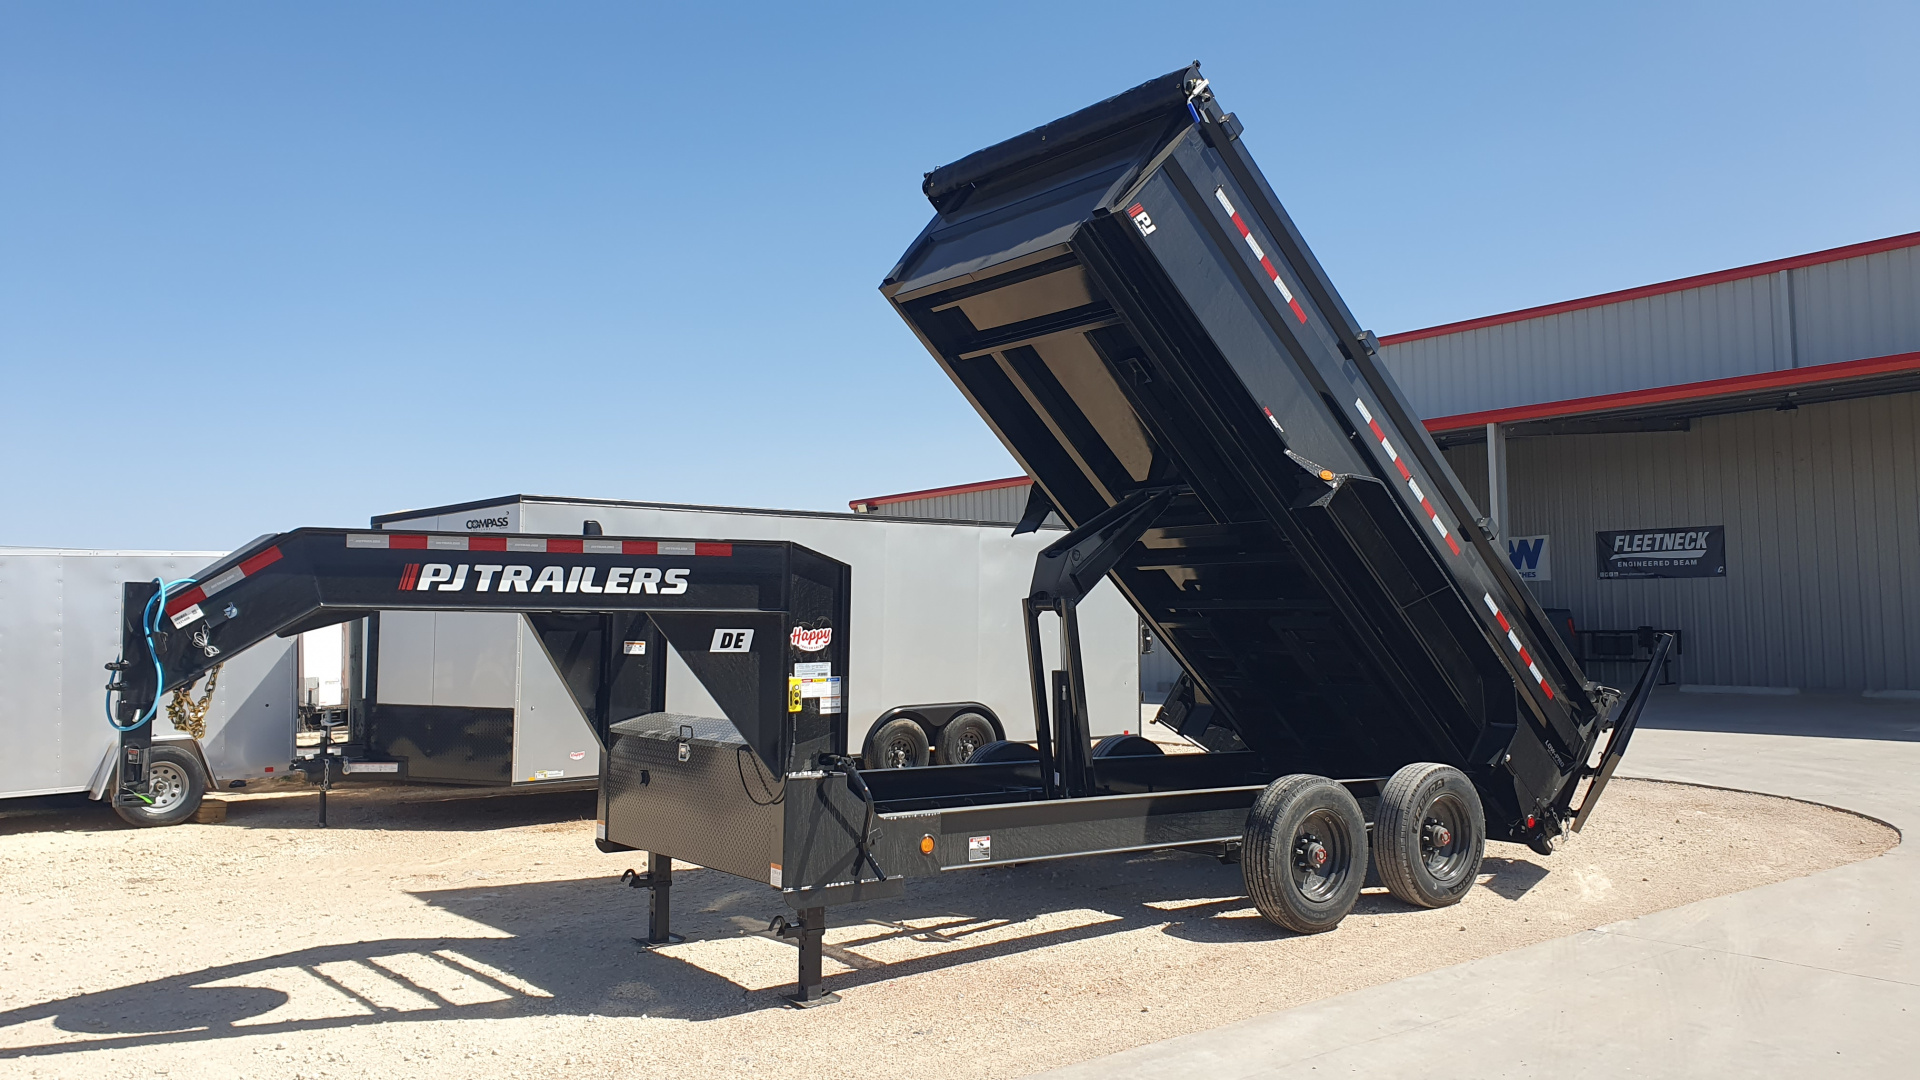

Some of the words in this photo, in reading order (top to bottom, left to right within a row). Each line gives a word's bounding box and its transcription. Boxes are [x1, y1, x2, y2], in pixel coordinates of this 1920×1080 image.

[1135, 211, 1157, 235] PJ
[466, 517, 509, 529] COMPASS
[1614, 532, 1709, 552] FLEETNECK
[416, 563, 469, 591] PJ
[474, 564, 691, 595] TRAILERS
[719, 632, 746, 649] DE
[792, 627, 831, 645] Happy
[1545, 739, 1565, 768] LOW-PRO
